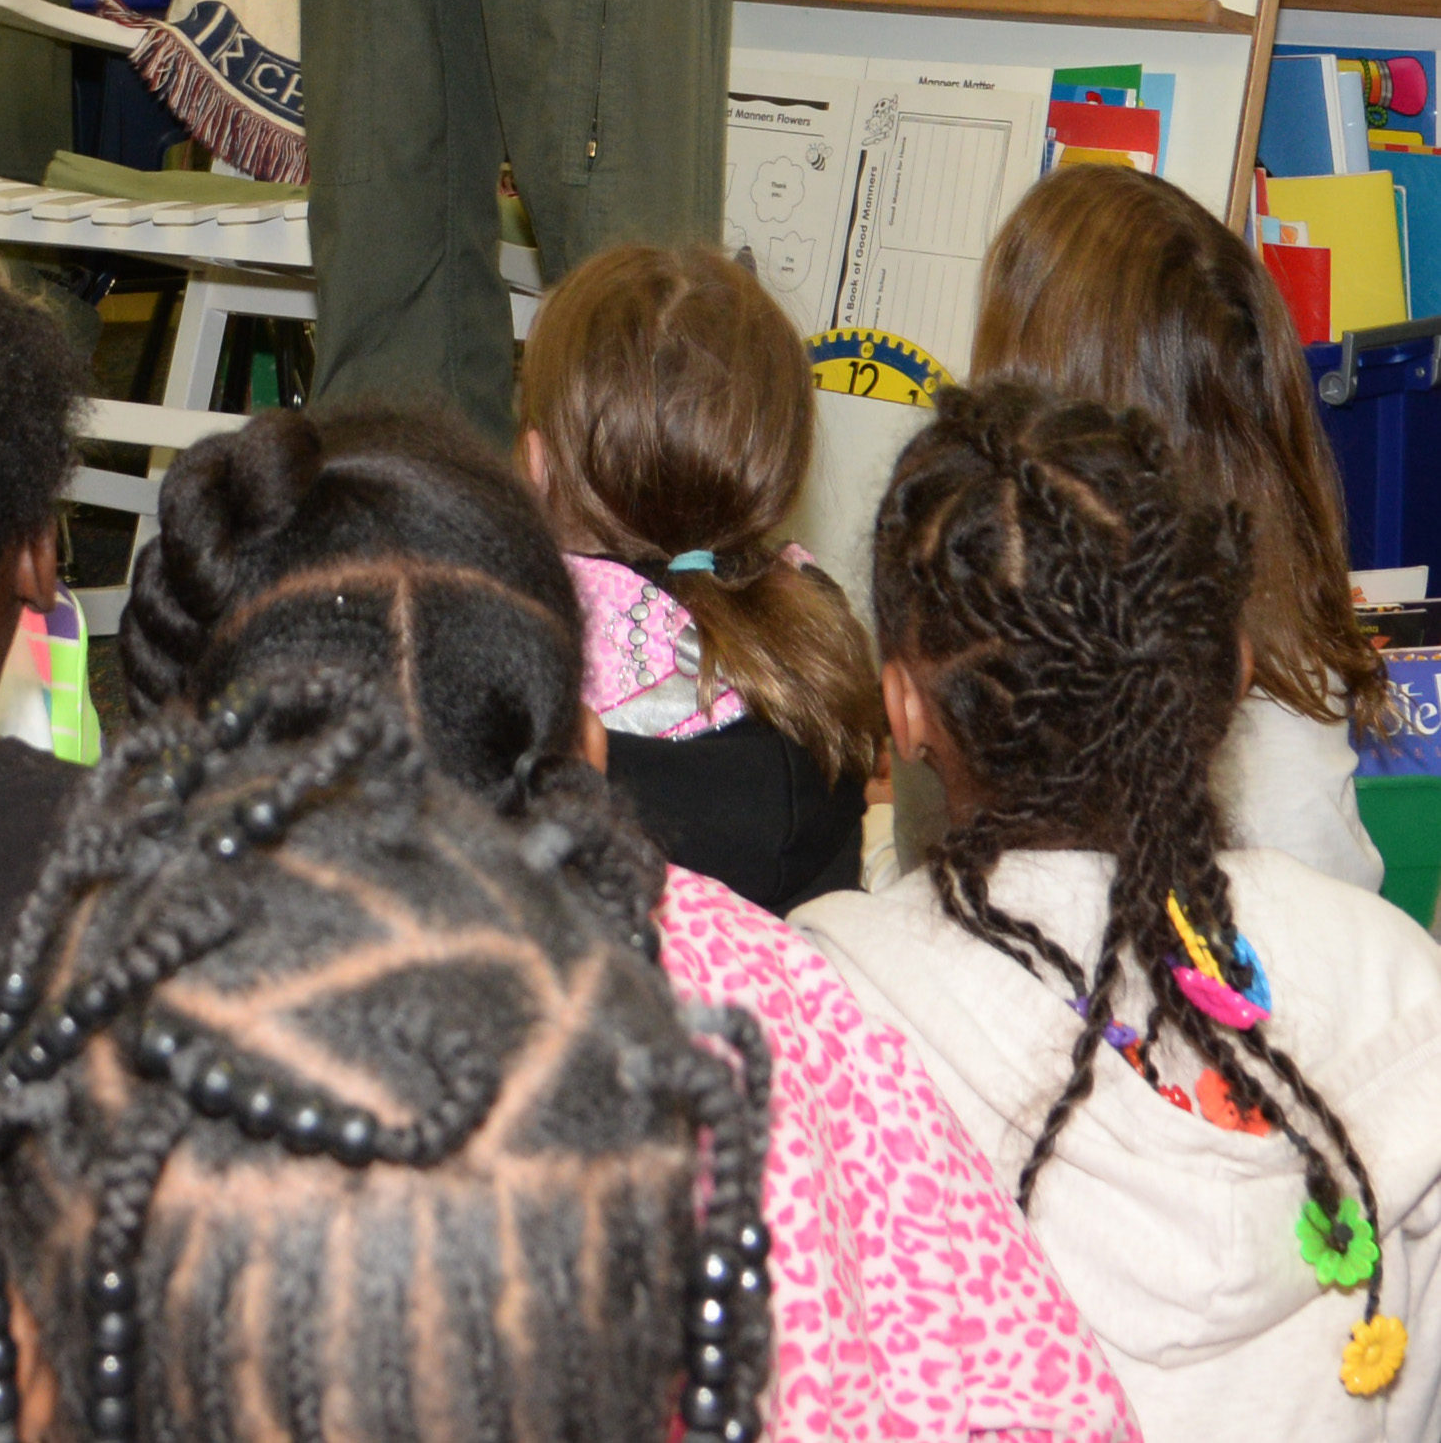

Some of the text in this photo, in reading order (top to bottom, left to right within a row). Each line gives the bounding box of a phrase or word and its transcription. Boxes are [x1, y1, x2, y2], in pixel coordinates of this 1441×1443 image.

[734, 108, 812, 127] Manners Flowers
[844, 165, 878, 324] A Book of Good Manners
[847, 360, 880, 396] 12
